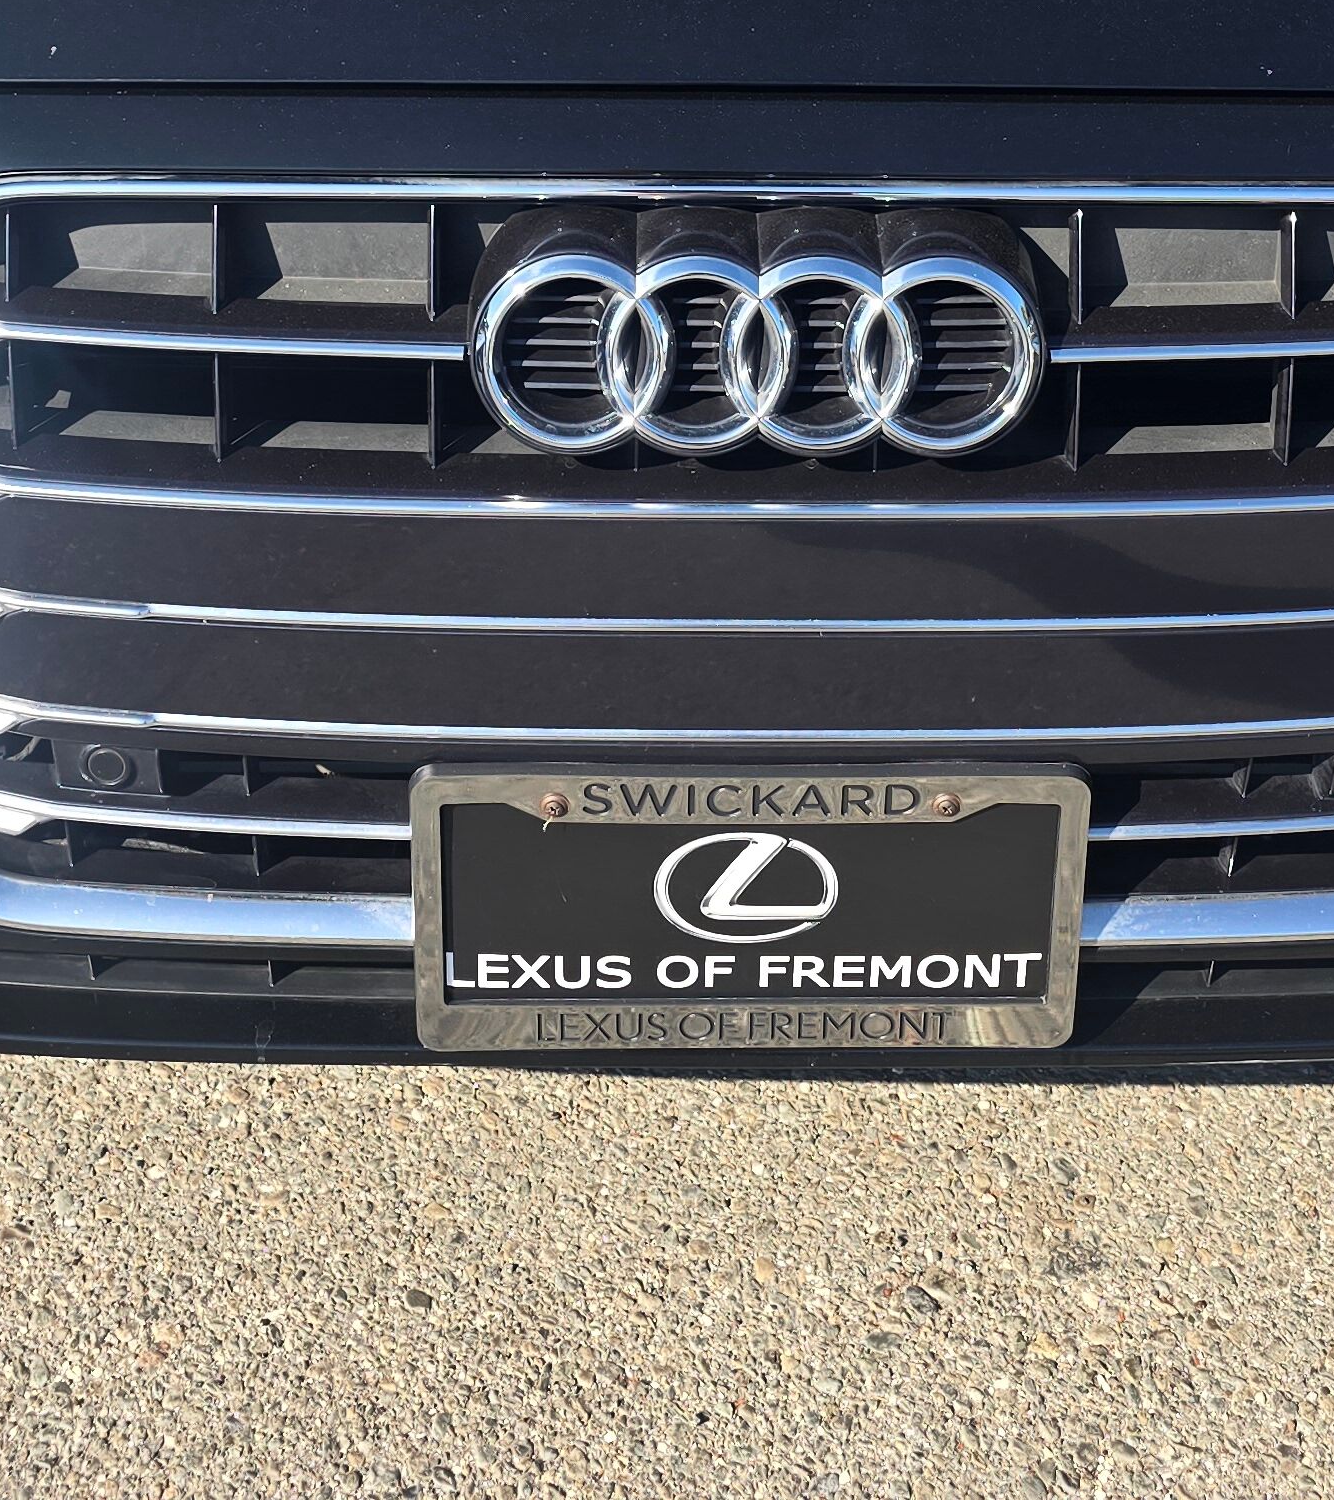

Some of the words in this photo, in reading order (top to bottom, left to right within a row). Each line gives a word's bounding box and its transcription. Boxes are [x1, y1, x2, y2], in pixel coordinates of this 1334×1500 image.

[581, 783, 922, 818] SWICKARD
[445, 951, 632, 989] LEXUS
[656, 954, 736, 989] OF
[758, 952, 1043, 989] FREMONT
[536, 1011, 668, 1042] LEXUS
[678, 1011, 740, 1042] OF
[747, 1010, 953, 1041] FREMONT
